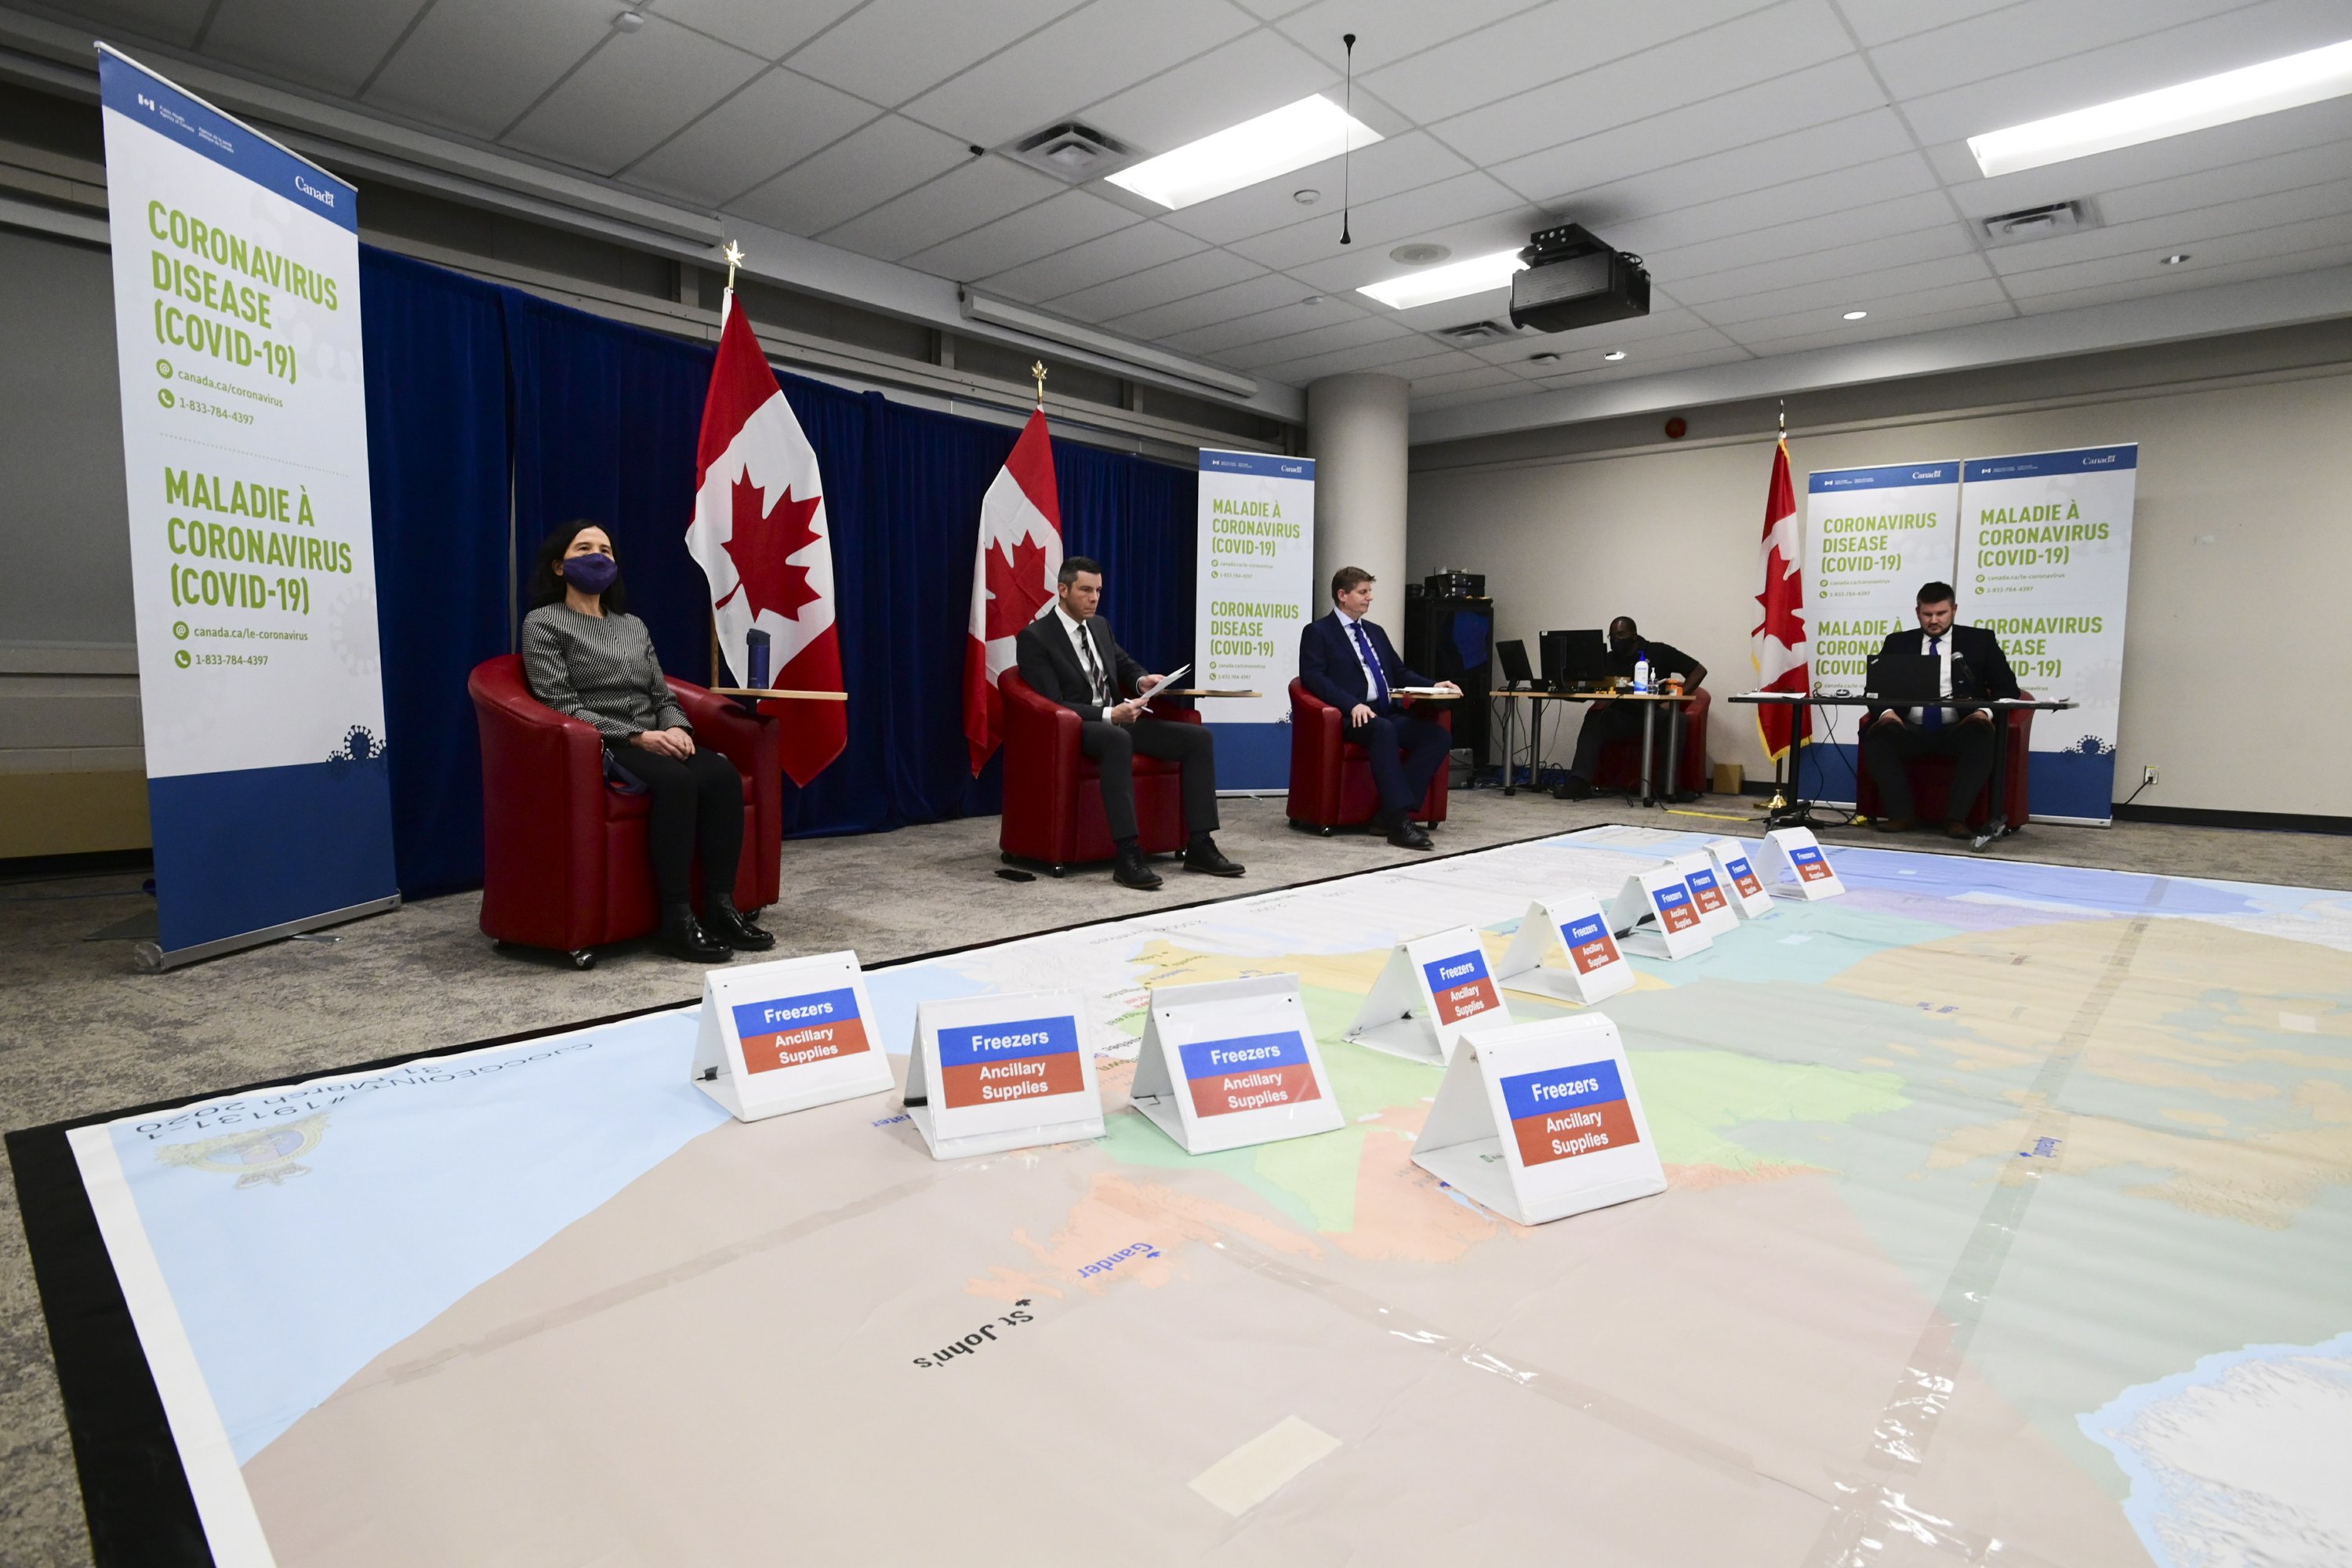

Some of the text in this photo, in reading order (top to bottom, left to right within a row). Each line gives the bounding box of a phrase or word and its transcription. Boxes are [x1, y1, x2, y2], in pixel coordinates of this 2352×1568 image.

[295, 176, 334, 208] Canada
[148, 200, 338, 311] CORONAVIRUS
[151, 250, 272, 329] DISEASE
[154, 298, 296, 384] (COVID-19)
[178, 369, 283, 408] canada.ca/coronavirus
[179, 397, 254, 426] 1-833-784-4397
[2082, 455, 2116, 466] Canada
[1912, 470, 1941, 481] Canada
[165, 466, 315, 527] MALADIE À
[1213, 499, 1281, 518] MALADIE À
[1980, 499, 2080, 526] MALADIE À
[1212, 518, 1300, 539] CORONAVIRUS
[1824, 512, 1936, 534] CORONAVIRUS
[1823, 535, 1888, 554] DISEASE
[1978, 522, 2109, 547] CORONAVIRUS
[168, 517, 352, 573] CORONAVIRUS
[1212, 538, 1276, 557] (COVID-19)
[1821, 554, 1901, 574] (COVID-19)
[1977, 545, 2070, 569] (COVID-19)
[171, 563, 310, 615] (COVID-19)
[1210, 601, 1298, 619] CORONAVIRUS
[194, 626, 308, 641] canada.ca/le-coronavirus
[1210, 621, 1263, 637] DISEASE
[1818, 620, 1888, 636] MALADIE
[1210, 640, 1274, 658] (COVID-19)
[1817, 641, 1883, 655] CORONA
[2002, 639, 2046, 655] EASE
[195, 654, 268, 666] 1-833-784-4397
[1816, 659, 1867, 676] (COVID
[1796, 850, 1816, 862] Freezers
[1692, 873, 1711, 887] Freezers
[1661, 888, 1682, 904] Freezers
[1670, 906, 1688, 920] Ancillary
[1674, 916, 1692, 930] Supplies
[1572, 921, 1598, 938] Freezers
[1582, 942, 1604, 957] Ancillary
[1587, 953, 1610, 968] Supplies
[1439, 960, 1475, 982] Freezers
[1449, 983, 1479, 1003] Ancillary
[764, 1000, 833, 1023] Freezers
[1454, 999, 1485, 1018] Supplies
[775, 1027, 834, 1048] Ancillary
[971, 1029, 1050, 1052] Freezers
[779, 1044, 838, 1065] Supplies
[1210, 1044, 1281, 1065] Freezers
[979, 1061, 1046, 1081] Ancillary
[264, 1076, 384, 1104] March
[982, 1080, 1048, 1100] Supplies
[1222, 1072, 1283, 1092] Ancillary
[1531, 1076, 1599, 1102] Freezers
[1227, 1088, 1288, 1110] Supplies
[136, 1102, 245, 1133] 2020
[1546, 1110, 1603, 1134] Ancillary
[1552, 1131, 1609, 1156] Supplies
[1077, 1242, 1153, 1279] Gander
[913, 1310, 1034, 1368] St John's
